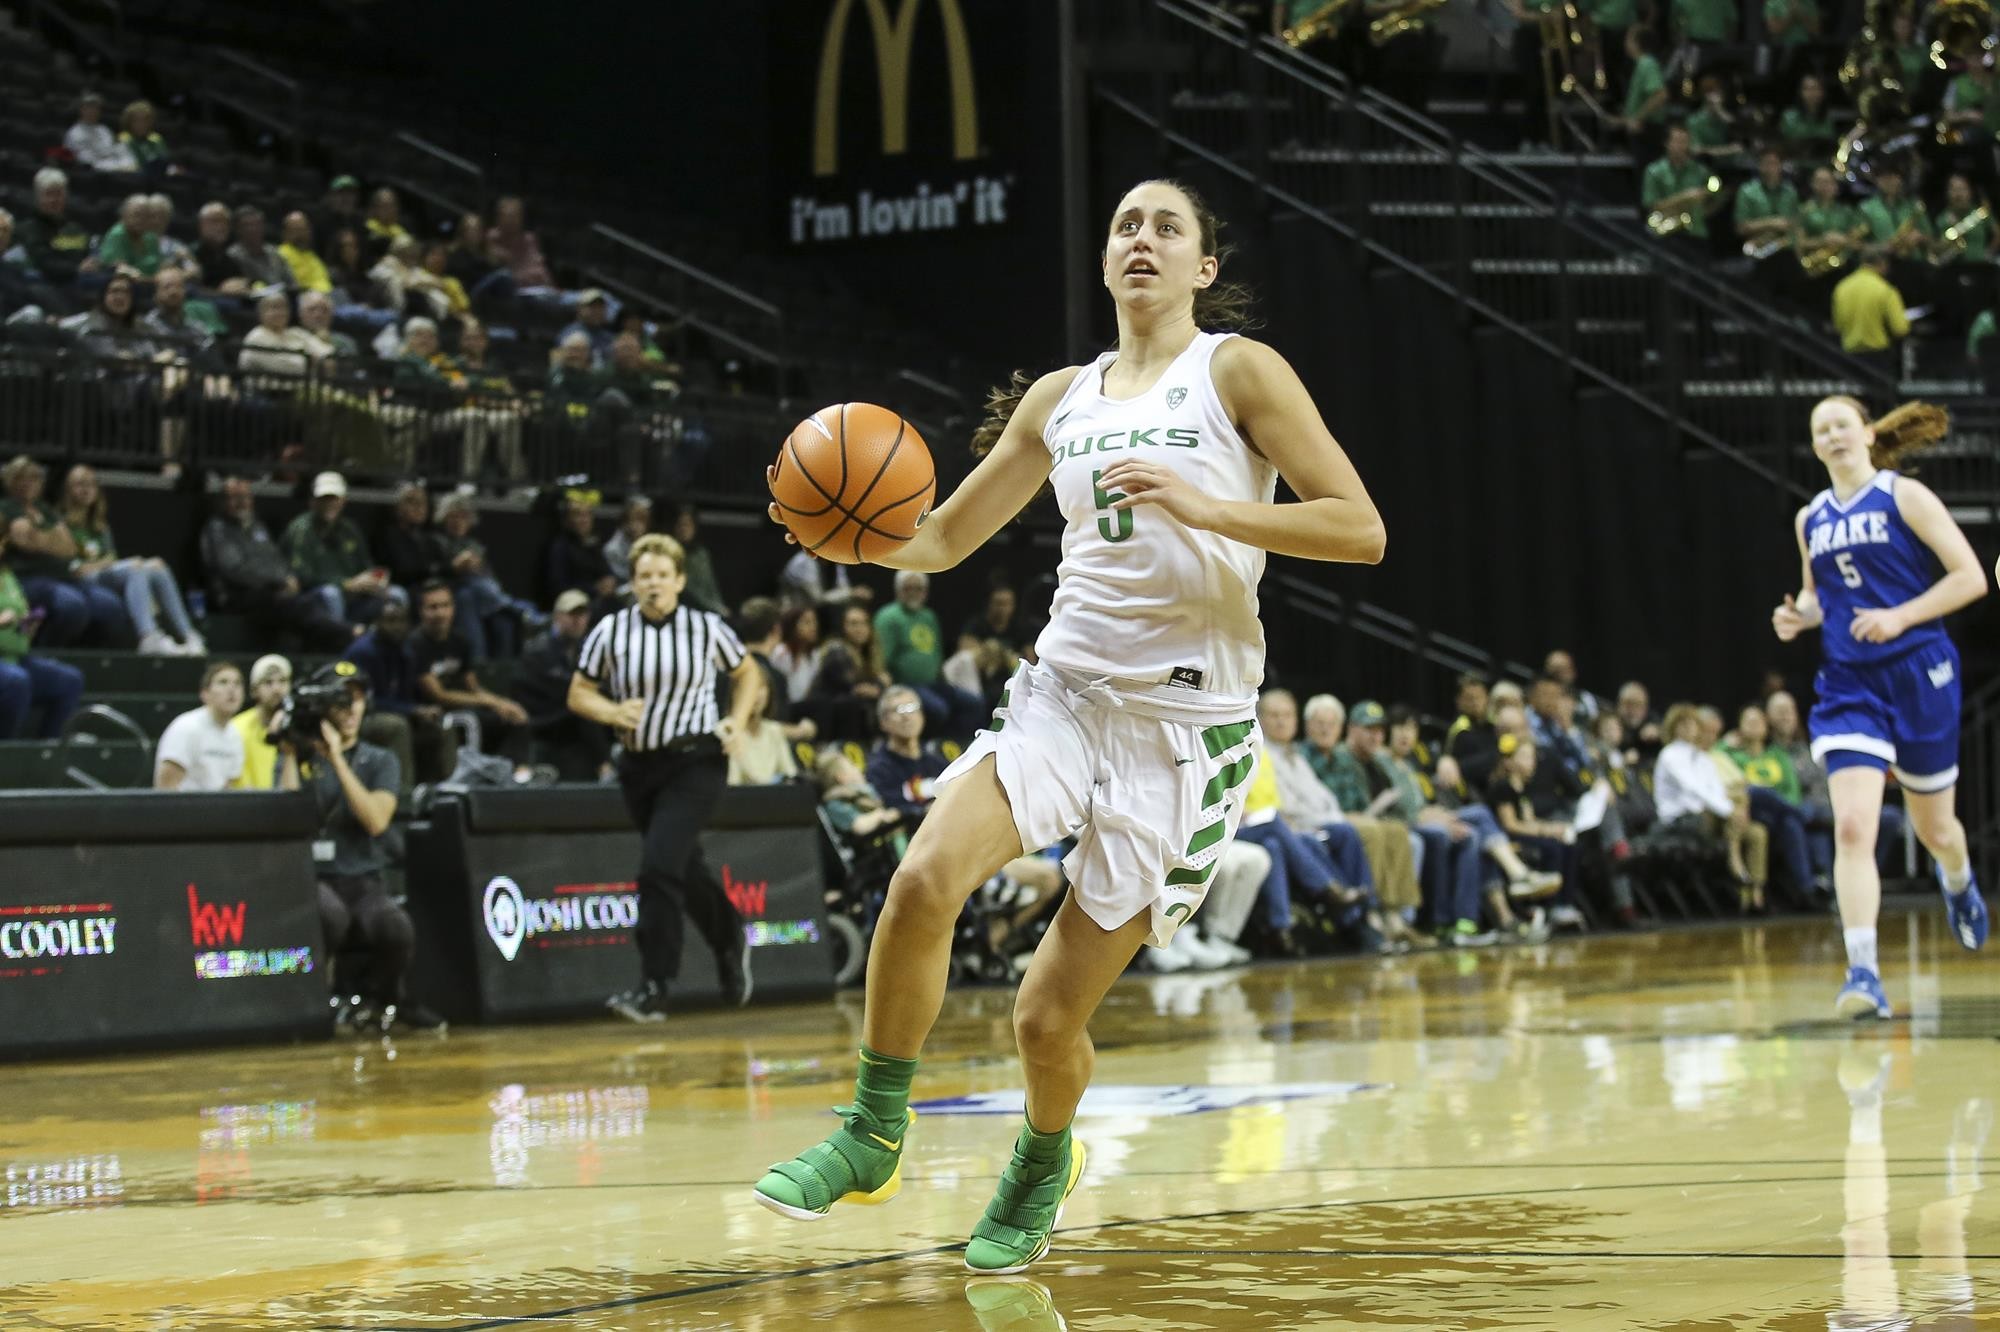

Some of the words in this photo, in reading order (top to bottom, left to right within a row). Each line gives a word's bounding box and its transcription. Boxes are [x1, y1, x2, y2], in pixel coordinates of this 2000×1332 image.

[791, 198, 849, 242] i'm
[858, 181, 969, 236] lovin'
[974, 176, 1006, 223] it
[1051, 427, 1200, 468] DUCKS
[1091, 469, 1134, 543] 5
[1808, 511, 1890, 559] DRAKE
[1834, 551, 1863, 589] 5
[0, 917, 117, 959] COOLEY
[187, 882, 248, 947] kw
